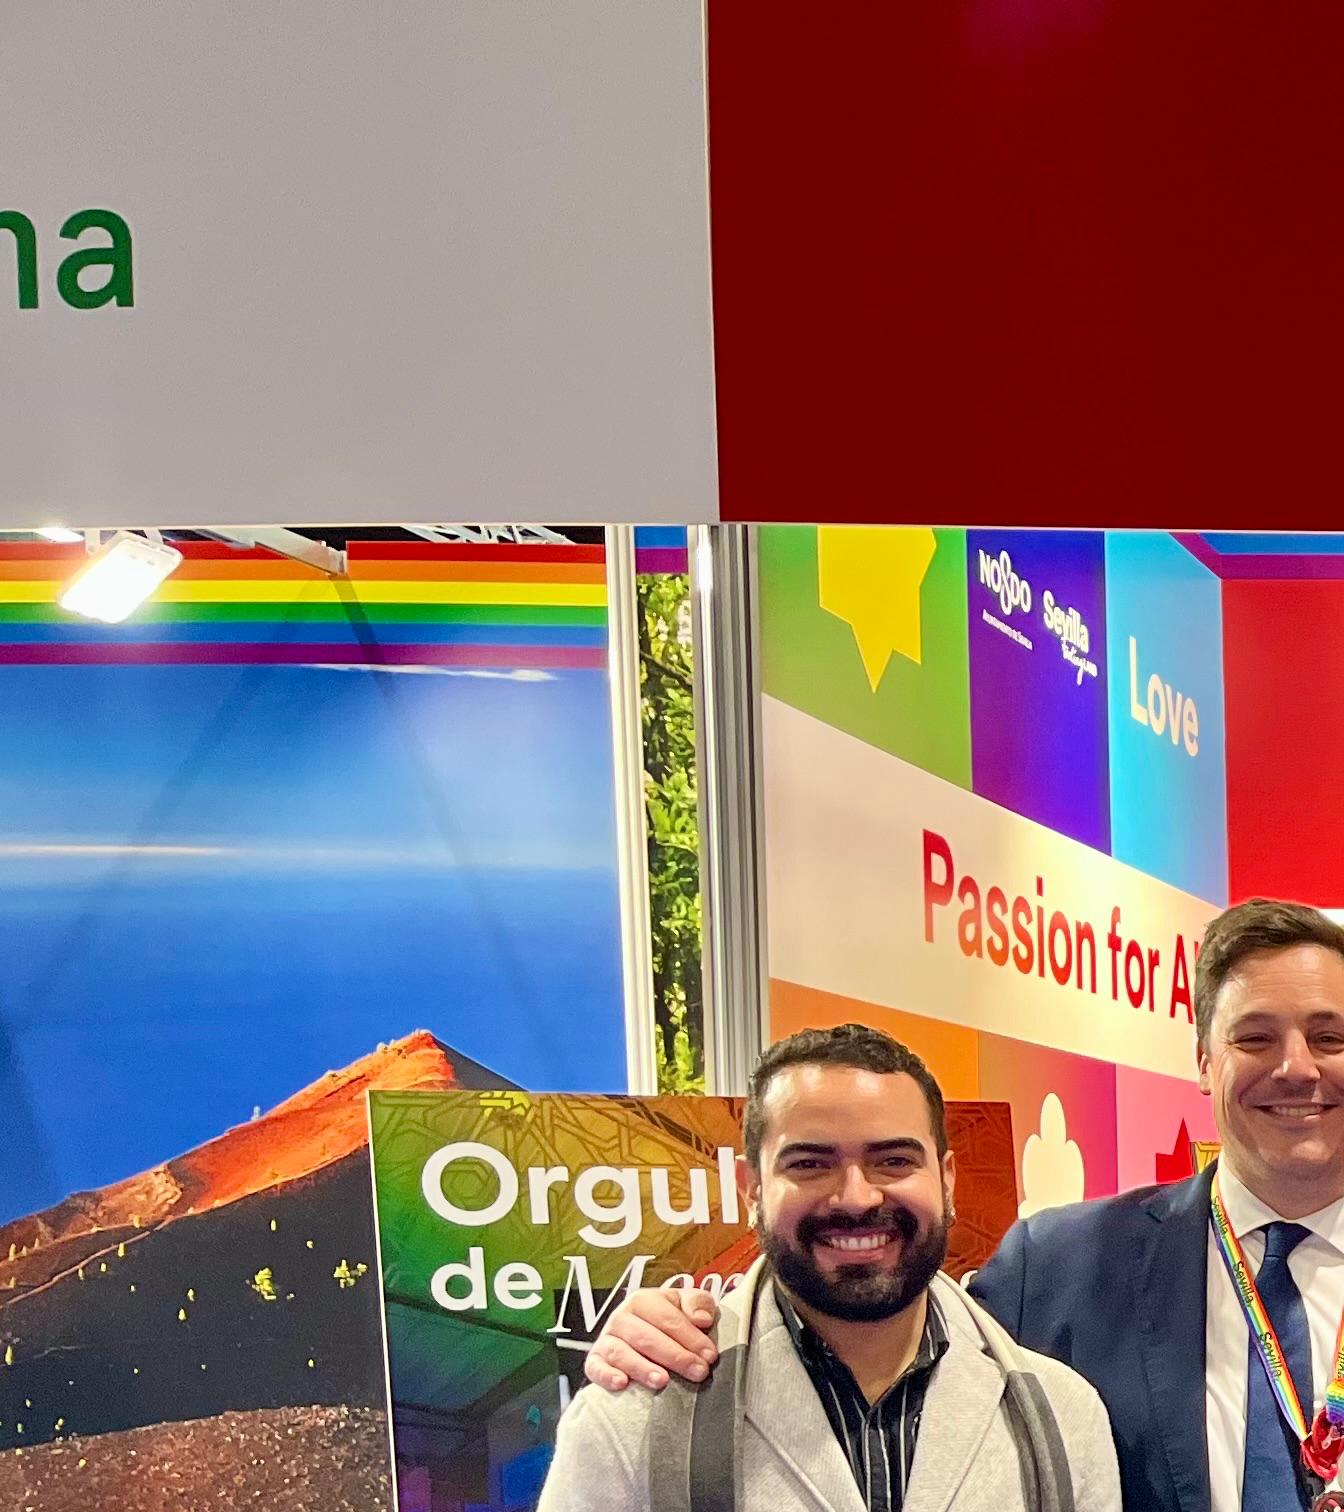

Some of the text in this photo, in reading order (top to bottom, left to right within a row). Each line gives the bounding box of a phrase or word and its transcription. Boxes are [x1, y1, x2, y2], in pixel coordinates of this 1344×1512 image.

[1043, 590, 1089, 653] Sevilla
[1128, 636, 1200, 757] Love
[922, 828, 1098, 995] Passion
[1108, 905, 1160, 1012] for
[422, 1141, 739, 1248] Orgul
[430, 1246, 543, 1310] de
